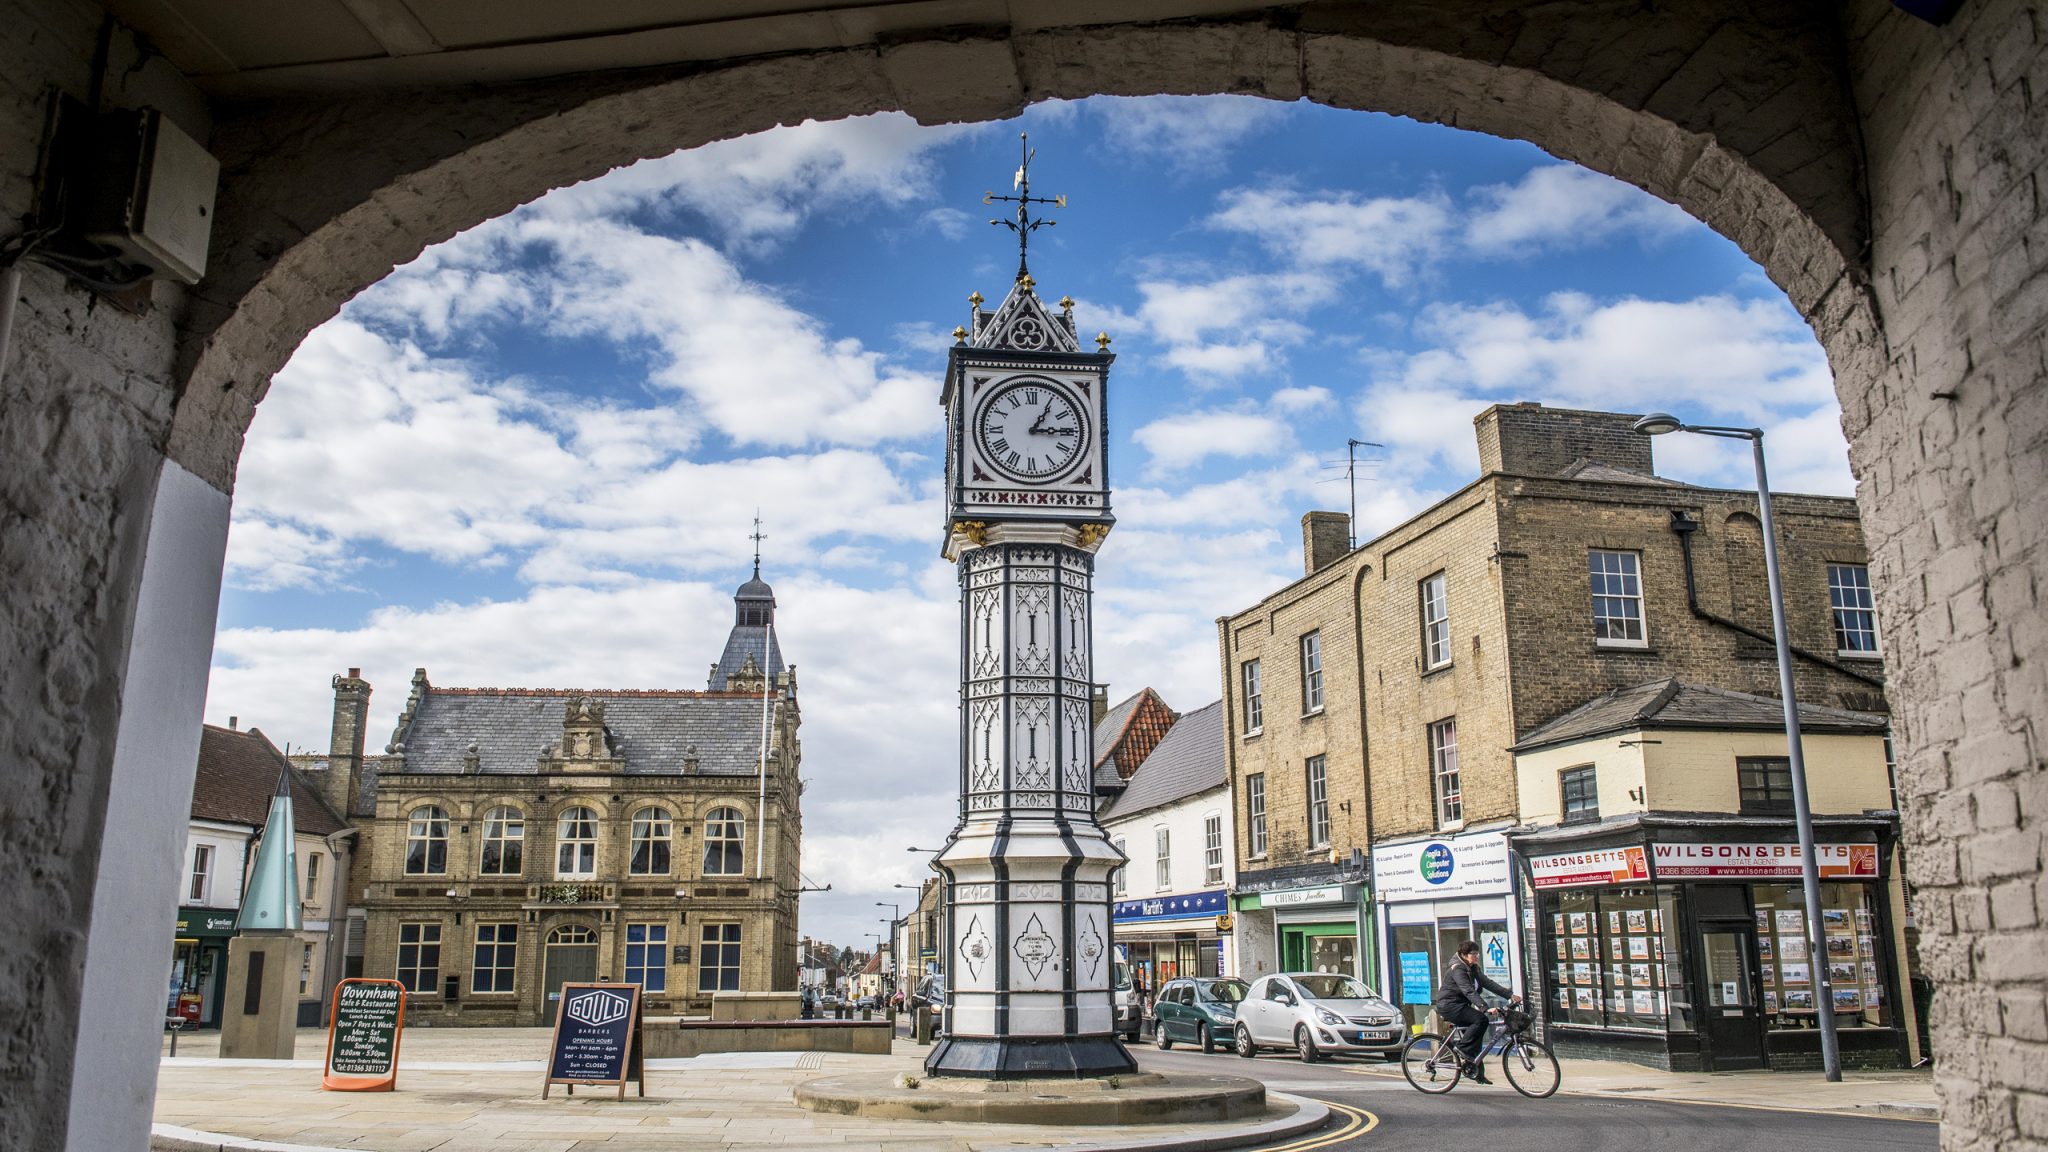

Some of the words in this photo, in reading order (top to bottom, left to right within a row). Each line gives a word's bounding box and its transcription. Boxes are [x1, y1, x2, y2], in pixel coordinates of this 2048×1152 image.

[1007, 395, 1021, 409] XI
[1025, 392, 1038, 405] XII
[994, 407, 1008, 419] X
[1055, 410, 1069, 420] II
[989, 425, 1003, 434] IX
[1426, 849, 1441, 859] Anglia
[1655, 846, 1847, 857] WILSON&BETS
[1426, 860, 1450, 870] Computer
[1532, 851, 1625, 869] WILSON&BETTS
[1426, 870, 1449, 880] Solutions
[1656, 867, 1679, 875] 01366
[1681, 867, 1710, 875] 385588
[1142, 901, 1164, 915] Martin's
[342, 986, 398, 999] Downham
[361, 1000, 397, 1008] Restaurant
[571, 994, 624, 1023] GOULD
[338, 1020, 352, 1028] Open
[347, 1064, 364, 1072] 01366
